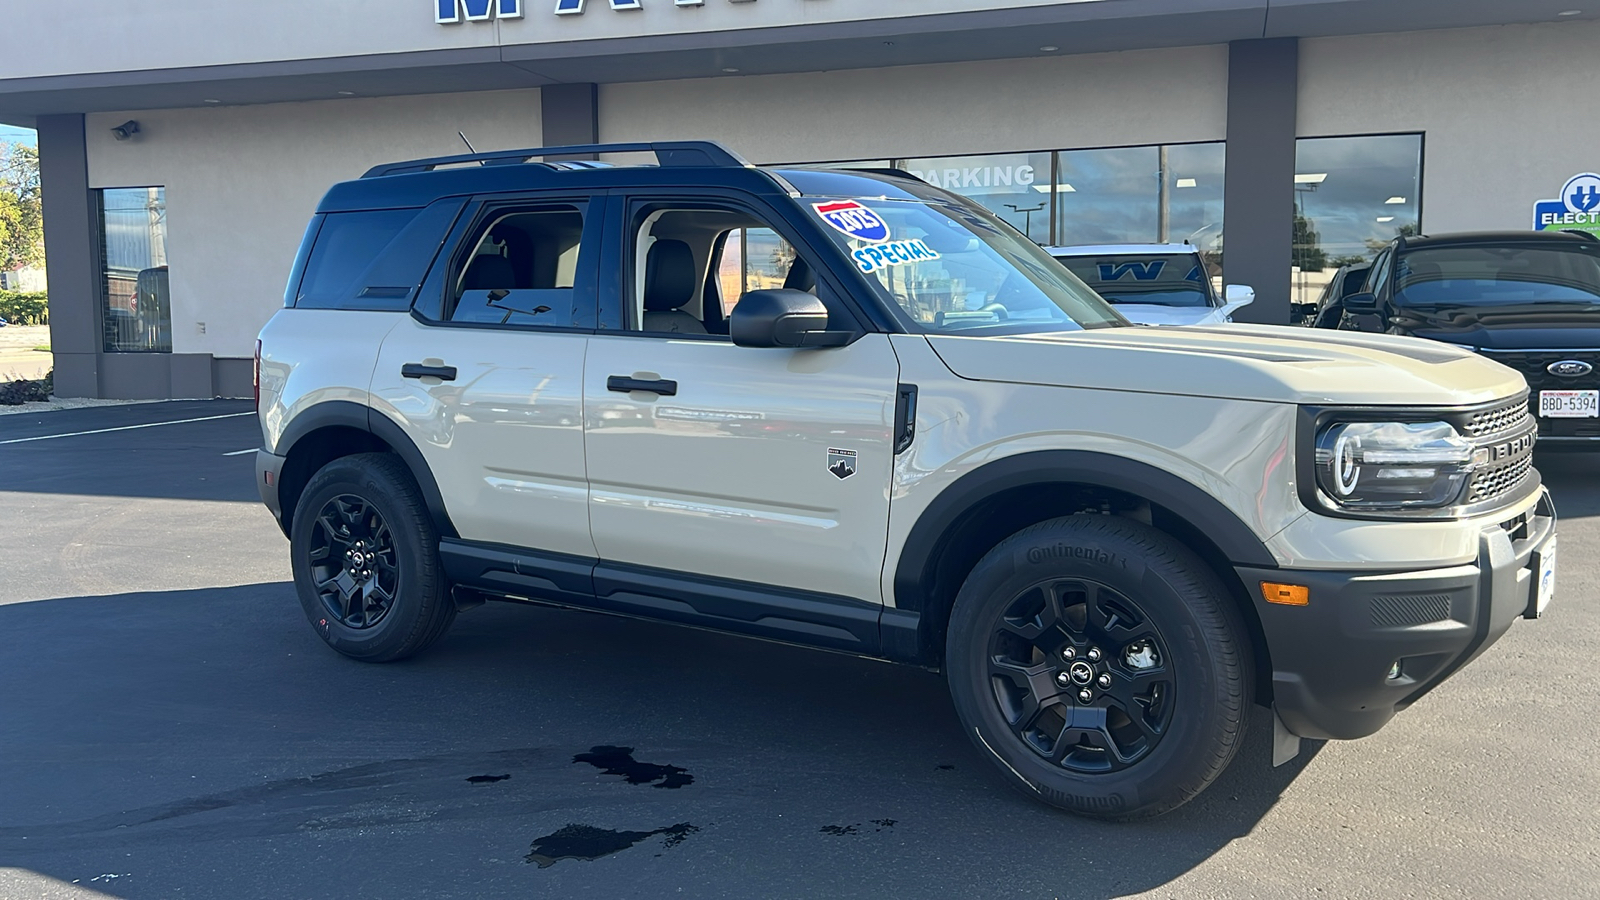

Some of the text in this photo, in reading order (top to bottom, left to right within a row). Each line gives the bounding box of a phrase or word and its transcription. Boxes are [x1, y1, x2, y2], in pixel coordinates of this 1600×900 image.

[830, 209, 880, 232] 2025
[854, 240, 937, 271] SPECIAL
[1542, 397, 1596, 411] BBD-5394
[1027, 542, 1116, 565] Continental
